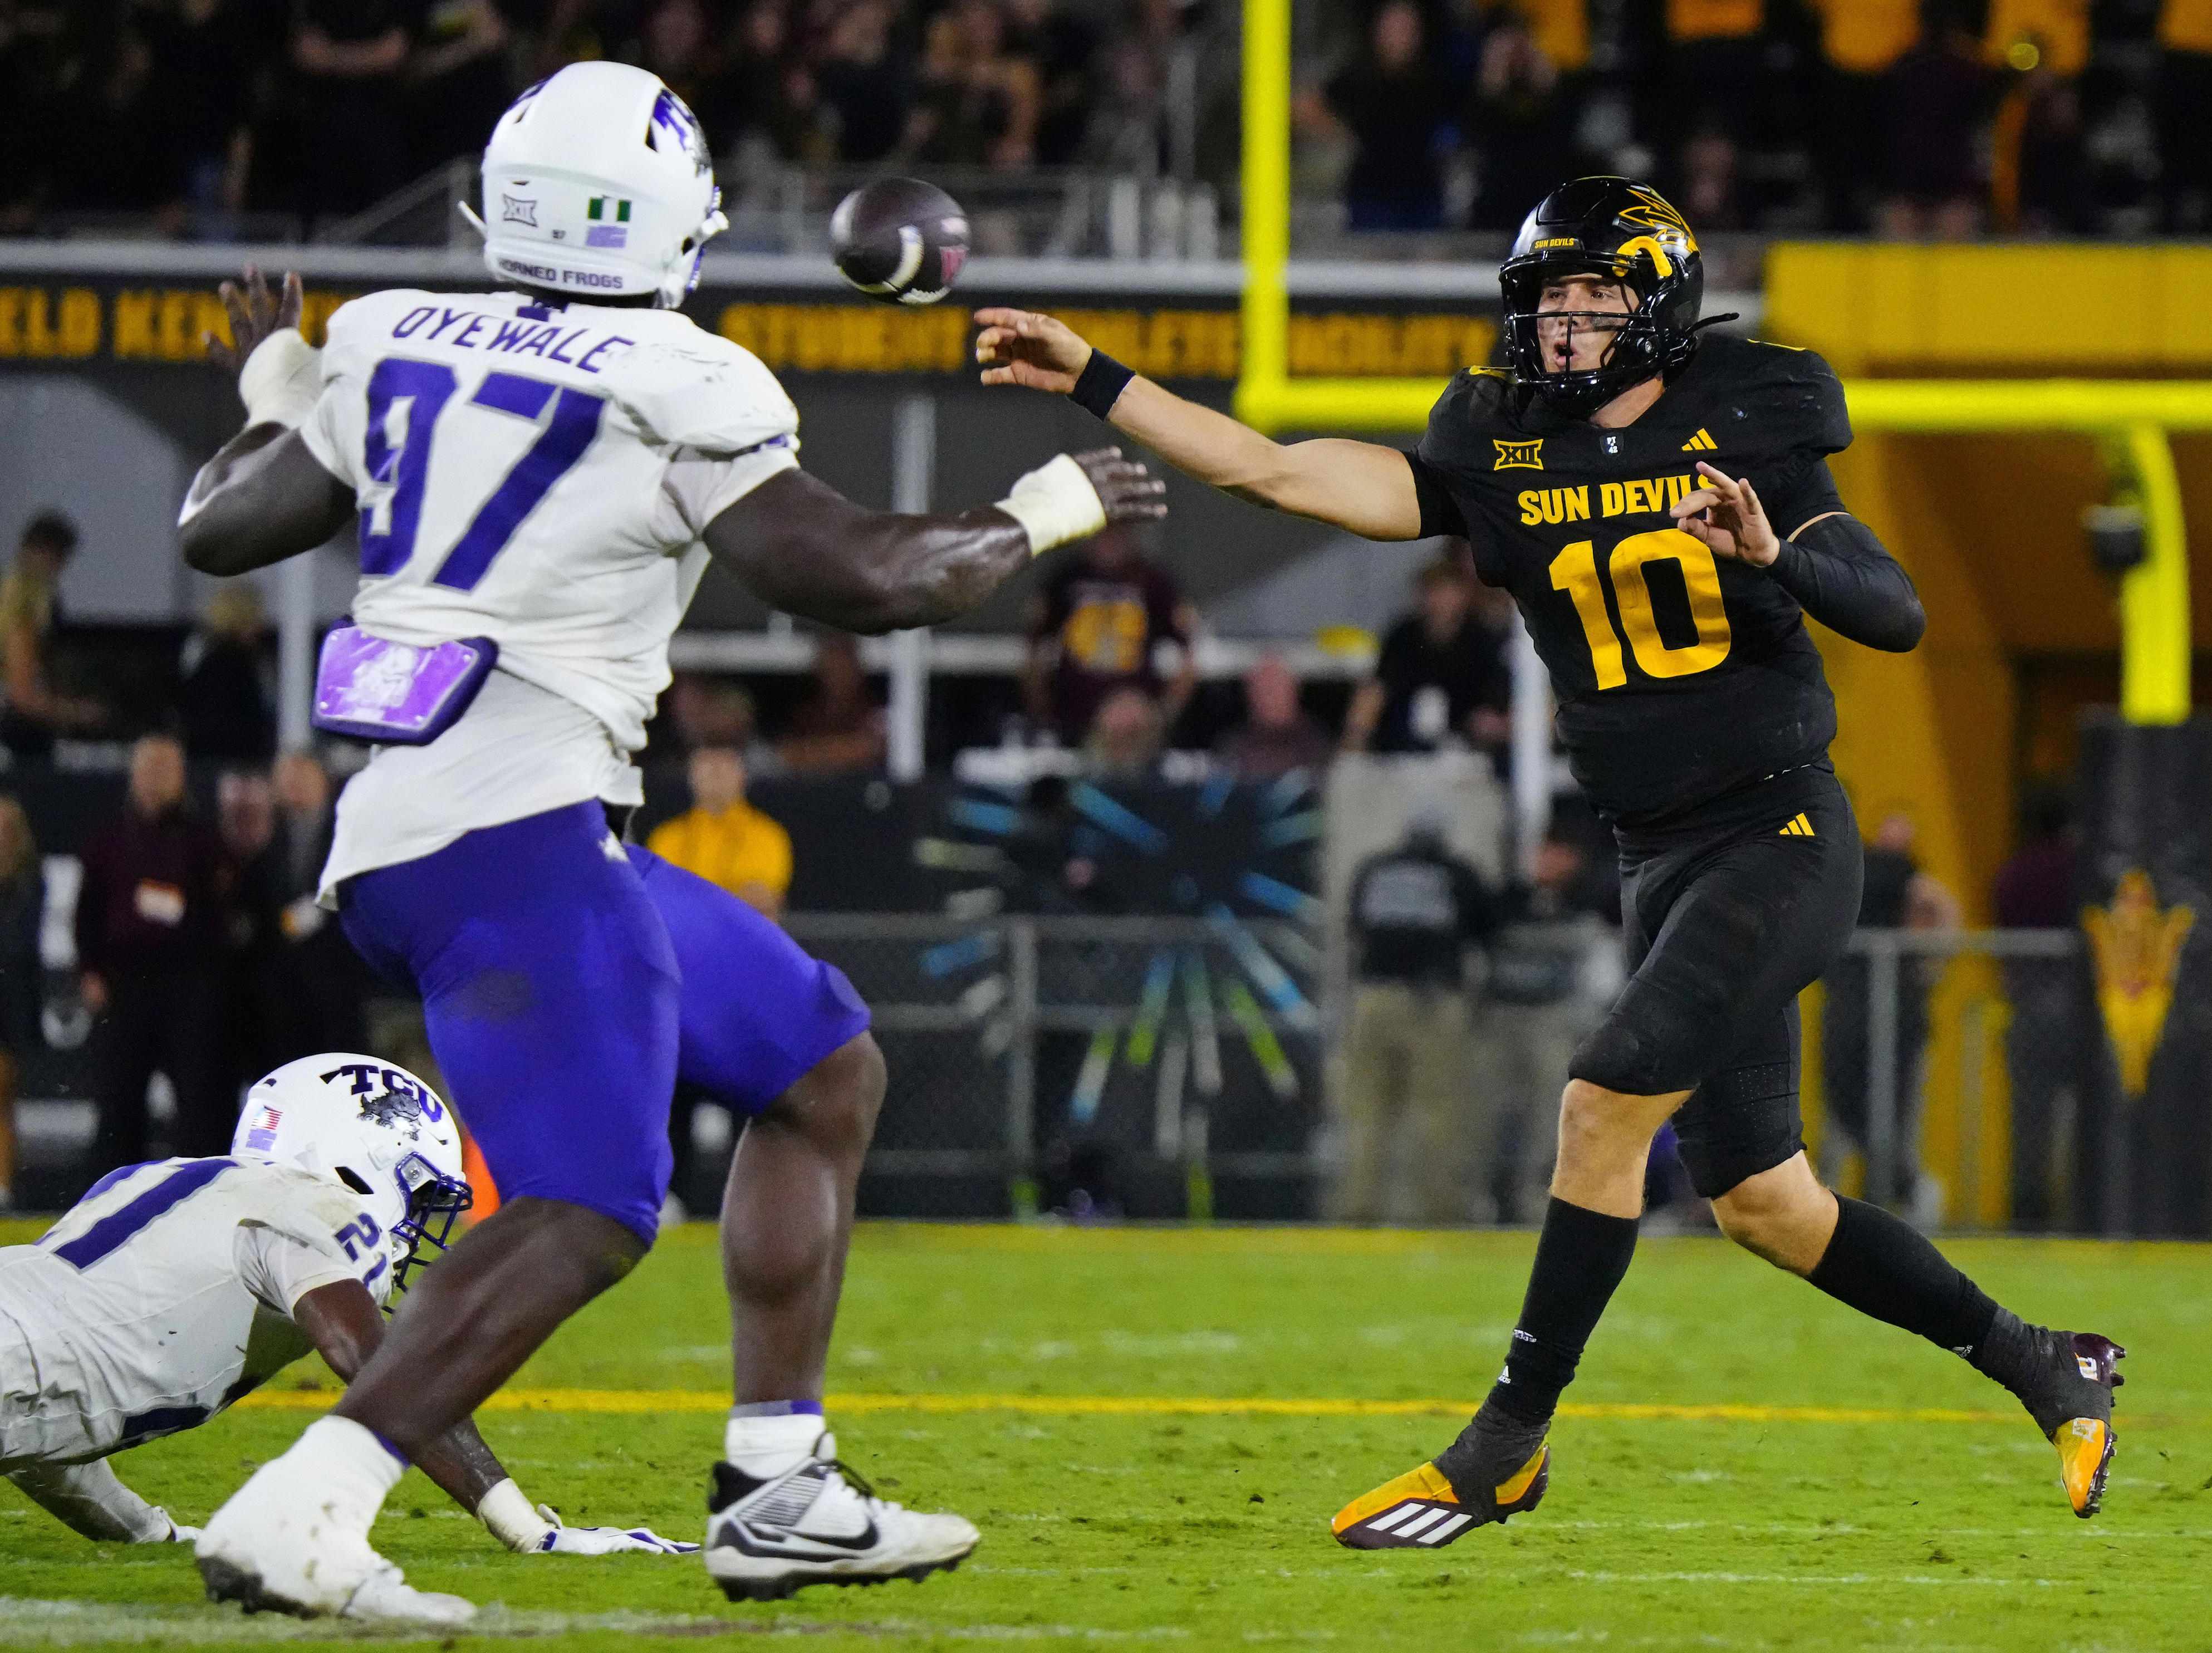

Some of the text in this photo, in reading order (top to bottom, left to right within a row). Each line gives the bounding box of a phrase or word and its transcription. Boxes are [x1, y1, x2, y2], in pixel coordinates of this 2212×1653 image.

[1535, 238, 1575, 248] SUN DEVILS
[563, 269, 623, 289] FROGS
[392, 307, 635, 374] OYEWALE
[361, 356, 607, 592] 97
[1518, 485, 1590, 526] SUN
[1548, 528, 1732, 690] 10
[340, 1064, 444, 1122] TCU
